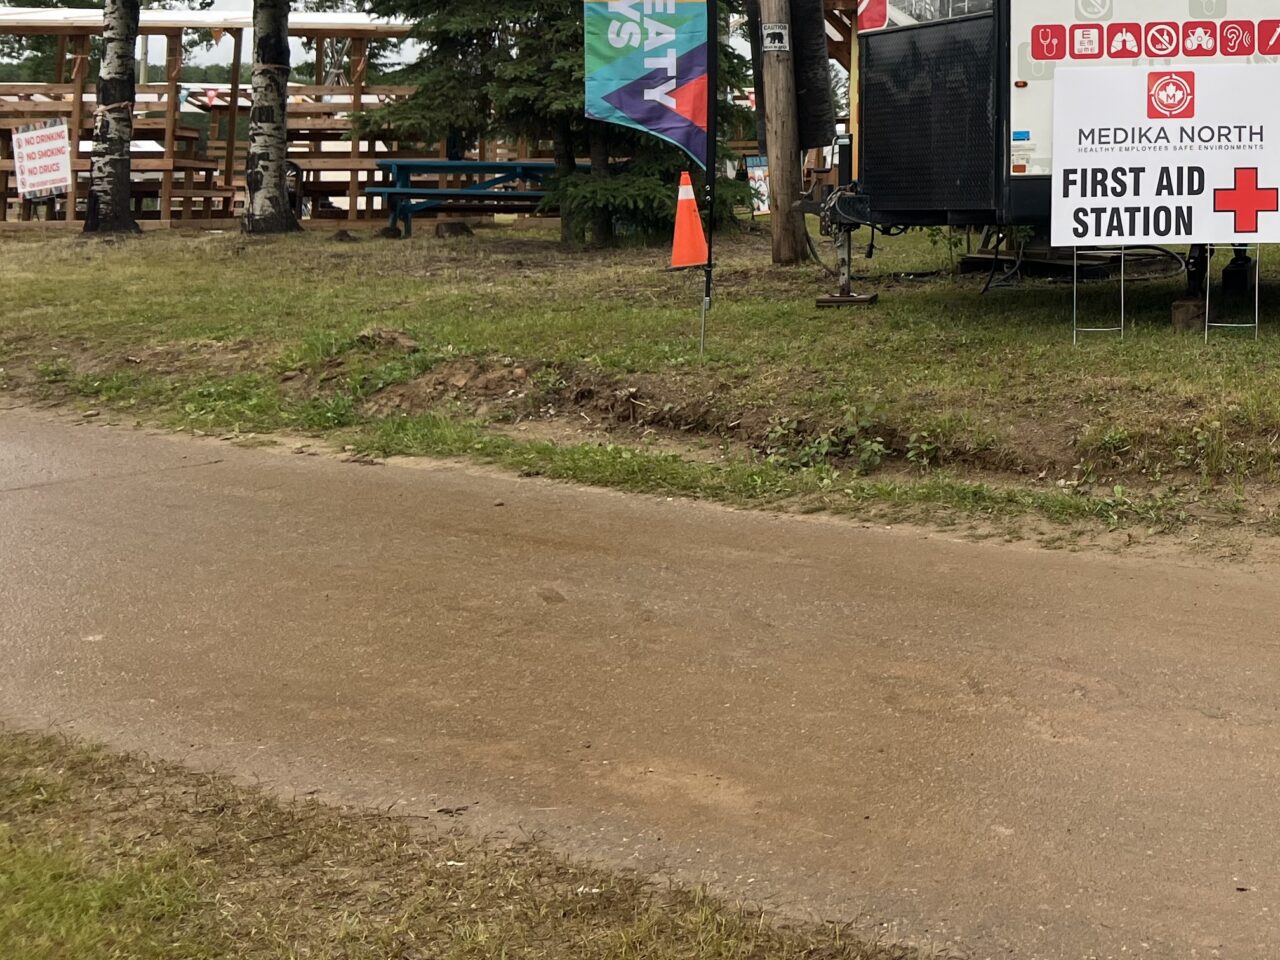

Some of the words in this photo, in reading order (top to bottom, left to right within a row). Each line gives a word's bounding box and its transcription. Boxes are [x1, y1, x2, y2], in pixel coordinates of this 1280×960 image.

[25, 136, 35, 146] NO
[36, 130, 65, 144] DRINKING
[1078, 126, 1170, 145] MEDIKA
[1179, 125, 1264, 143] NORTH
[26, 151, 36, 161] NO
[37, 146, 65, 159] SMOKING
[28, 166, 38, 176] NO
[39, 162, 60, 174] DRUGS
[1062, 166, 1146, 198] FIRST
[1155, 166, 1205, 196] AID
[1072, 205, 1193, 238] STATION
